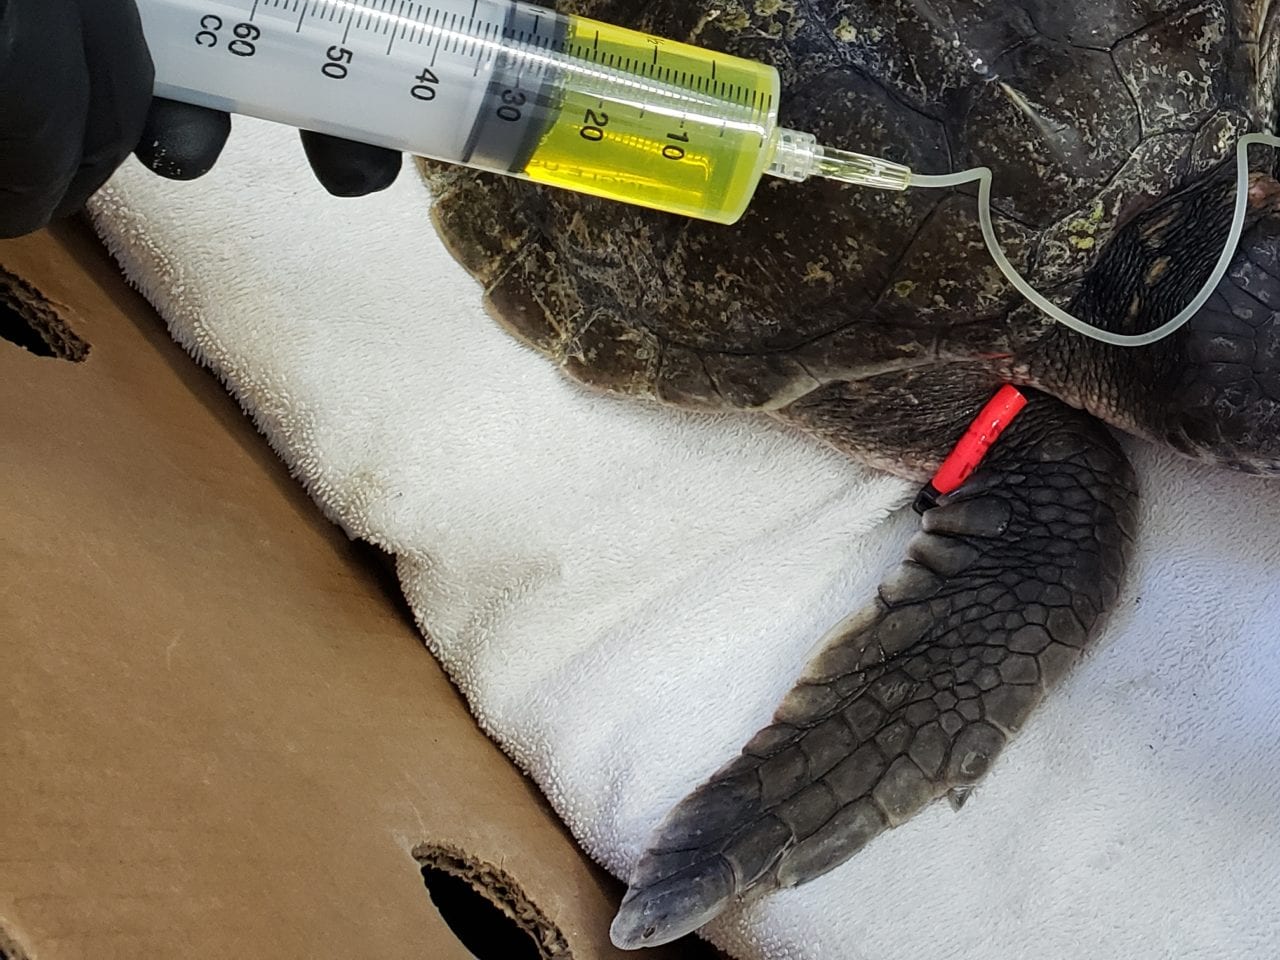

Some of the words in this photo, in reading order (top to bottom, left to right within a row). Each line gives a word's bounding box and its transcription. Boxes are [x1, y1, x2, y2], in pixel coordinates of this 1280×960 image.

[228, 22, 261, 57] 60
[321, 45, 353, 80] 50
[410, 67, 440, 101] 40
[496, 89, 526, 122] 30
[580, 109, 609, 141] 20
[662, 132, 689, 160] 10
